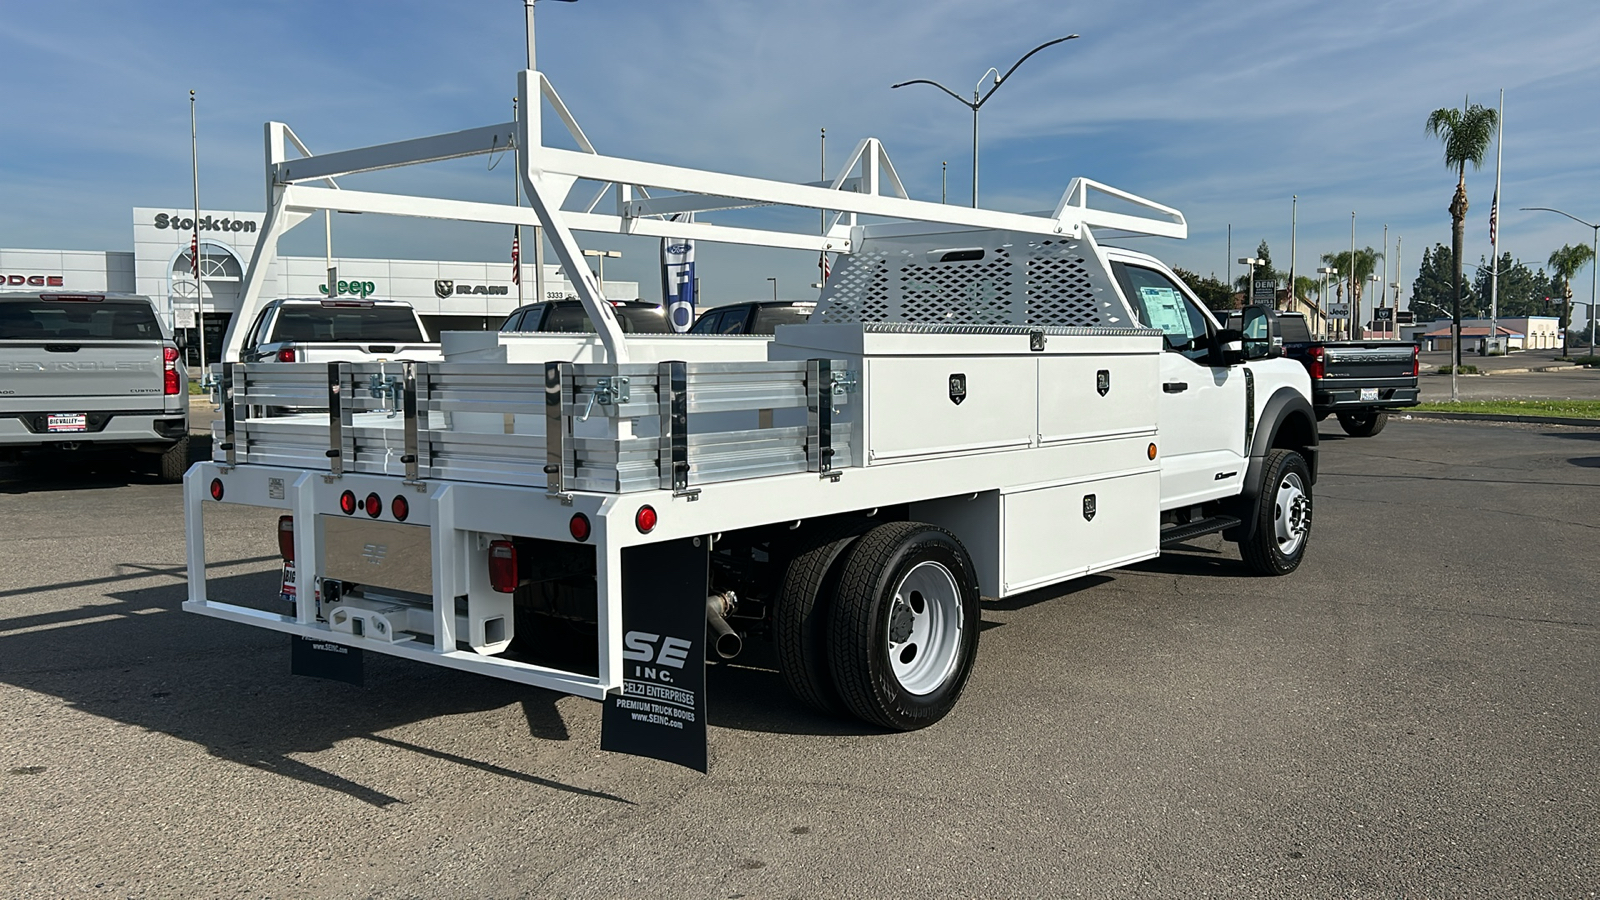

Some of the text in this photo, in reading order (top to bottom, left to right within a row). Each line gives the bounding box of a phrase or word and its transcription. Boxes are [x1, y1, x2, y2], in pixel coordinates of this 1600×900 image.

[154, 213, 256, 232] Stockton
[0, 275, 63, 286] DGE
[456, 285, 508, 295] RAM
[0, 361, 150, 371] HEVROLET
[623, 630, 692, 669] SE
[635, 665, 674, 683] INC.
[622, 682, 695, 706] CELZI ENTERPRISES
[616, 698, 695, 722] PREMIUM TRUCK BODIES
[631, 712, 683, 729] www.SEINC.com
